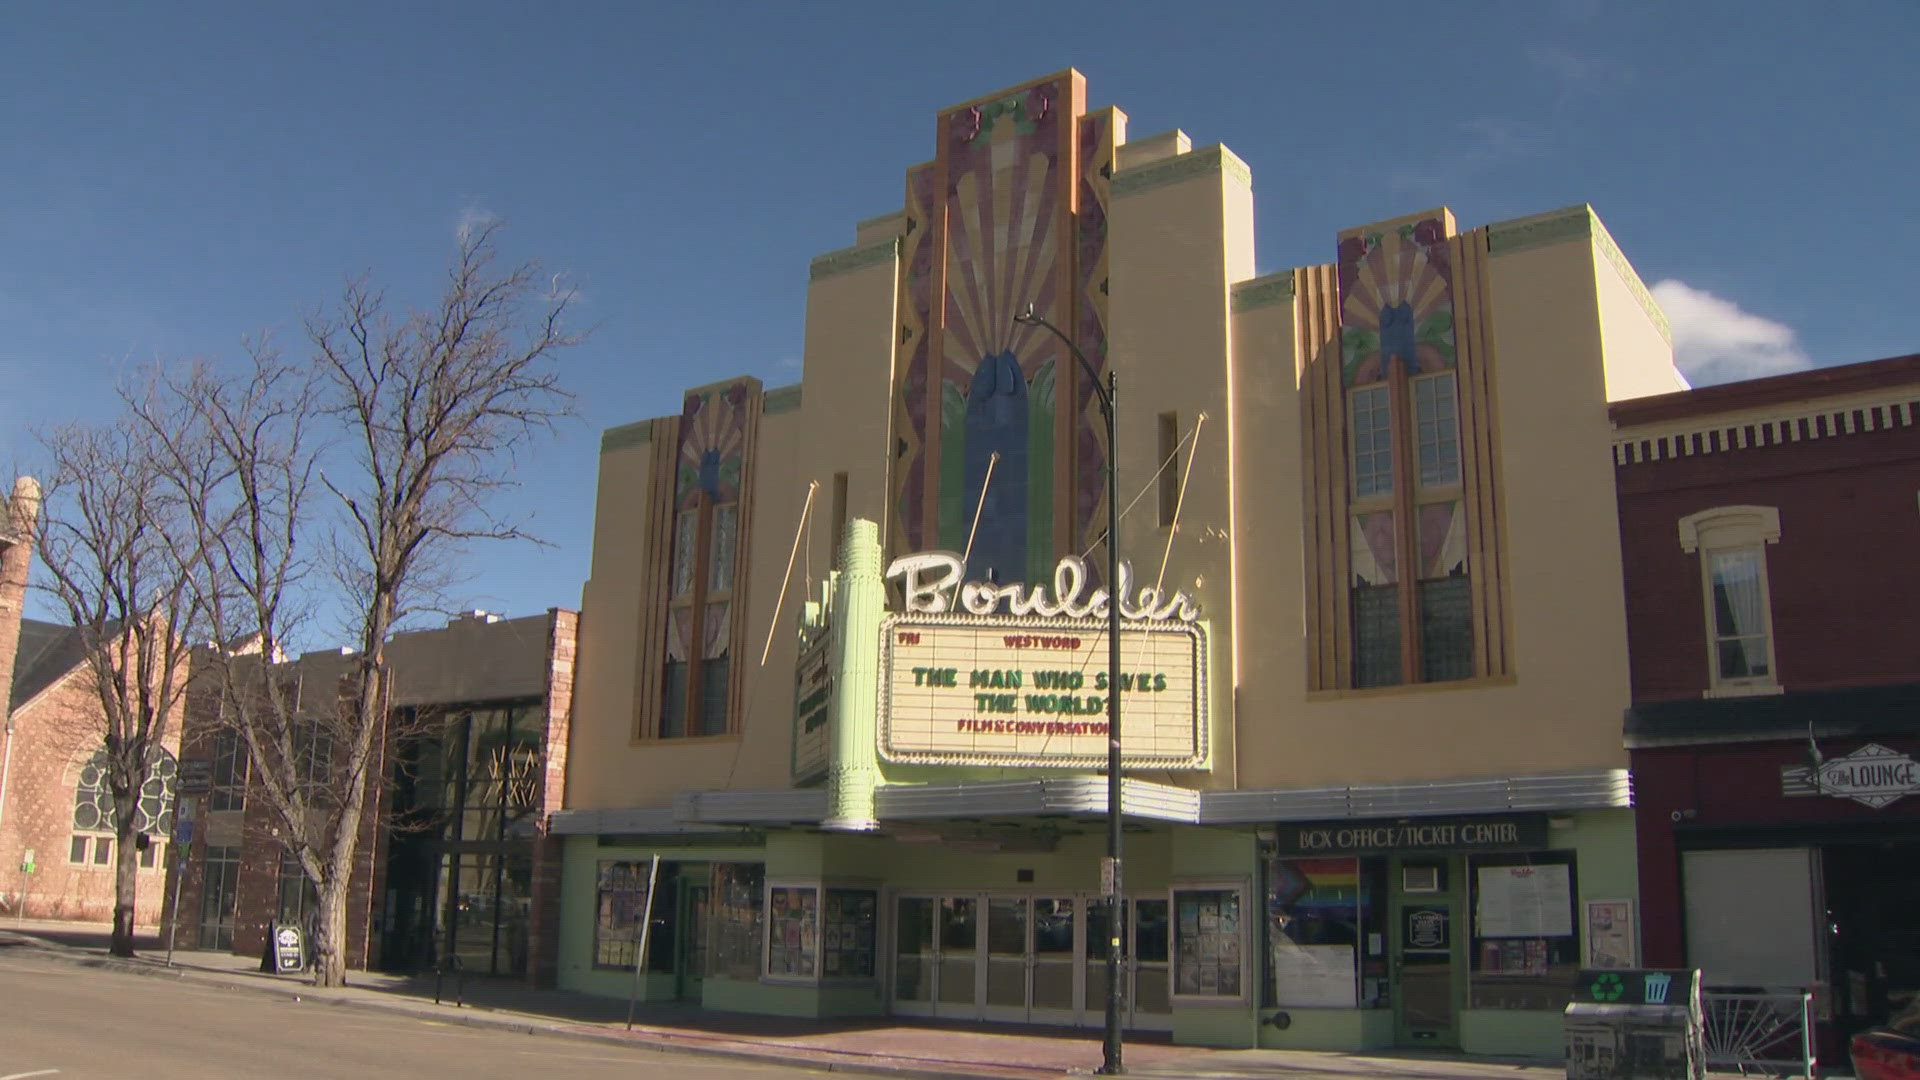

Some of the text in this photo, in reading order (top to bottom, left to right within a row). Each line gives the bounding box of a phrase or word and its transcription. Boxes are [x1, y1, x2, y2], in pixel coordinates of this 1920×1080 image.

[886, 552, 1203, 622] Boulder
[1003, 635, 1081, 650] WESTWORD
[911, 667, 1167, 692] THE MAN WHO SVES
[975, 693, 1018, 714] THE
[1826, 763, 1918, 787] The LOUNGE
[1300, 831, 1332, 849] BOX
[1461, 823, 1519, 843] CENTER
